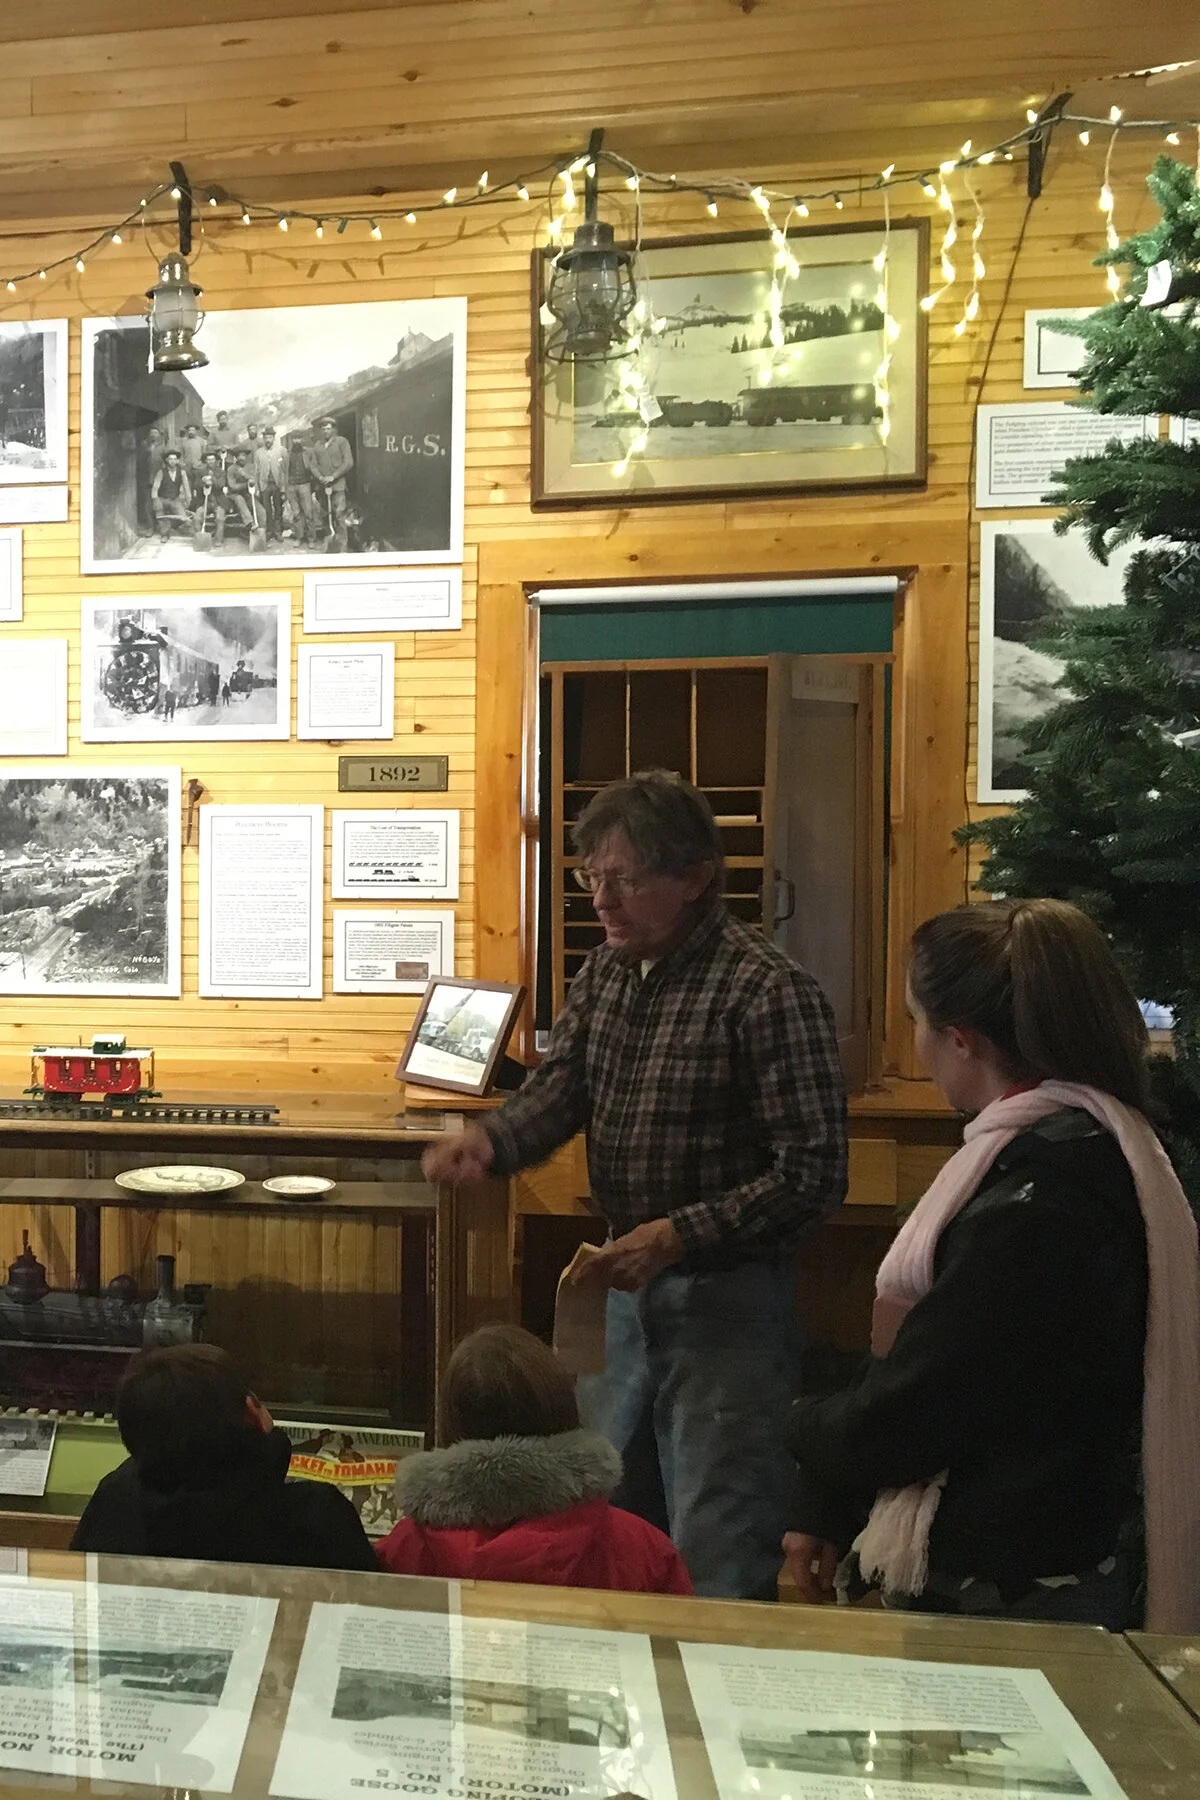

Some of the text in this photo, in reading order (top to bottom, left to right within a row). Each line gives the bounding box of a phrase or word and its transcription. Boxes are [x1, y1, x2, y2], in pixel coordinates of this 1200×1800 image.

[384, 433, 446, 456] R.G.S.
[368, 765, 420, 782] 1892
[48, 1745, 137, 1763] MOTOR
[105, 1740, 145, 1752] (The
[400, 1770, 442, 1784] NO.
[350, 1778, 438, 1796] GOOSE
[459, 1776, 570, 1797] (MOTOR)
